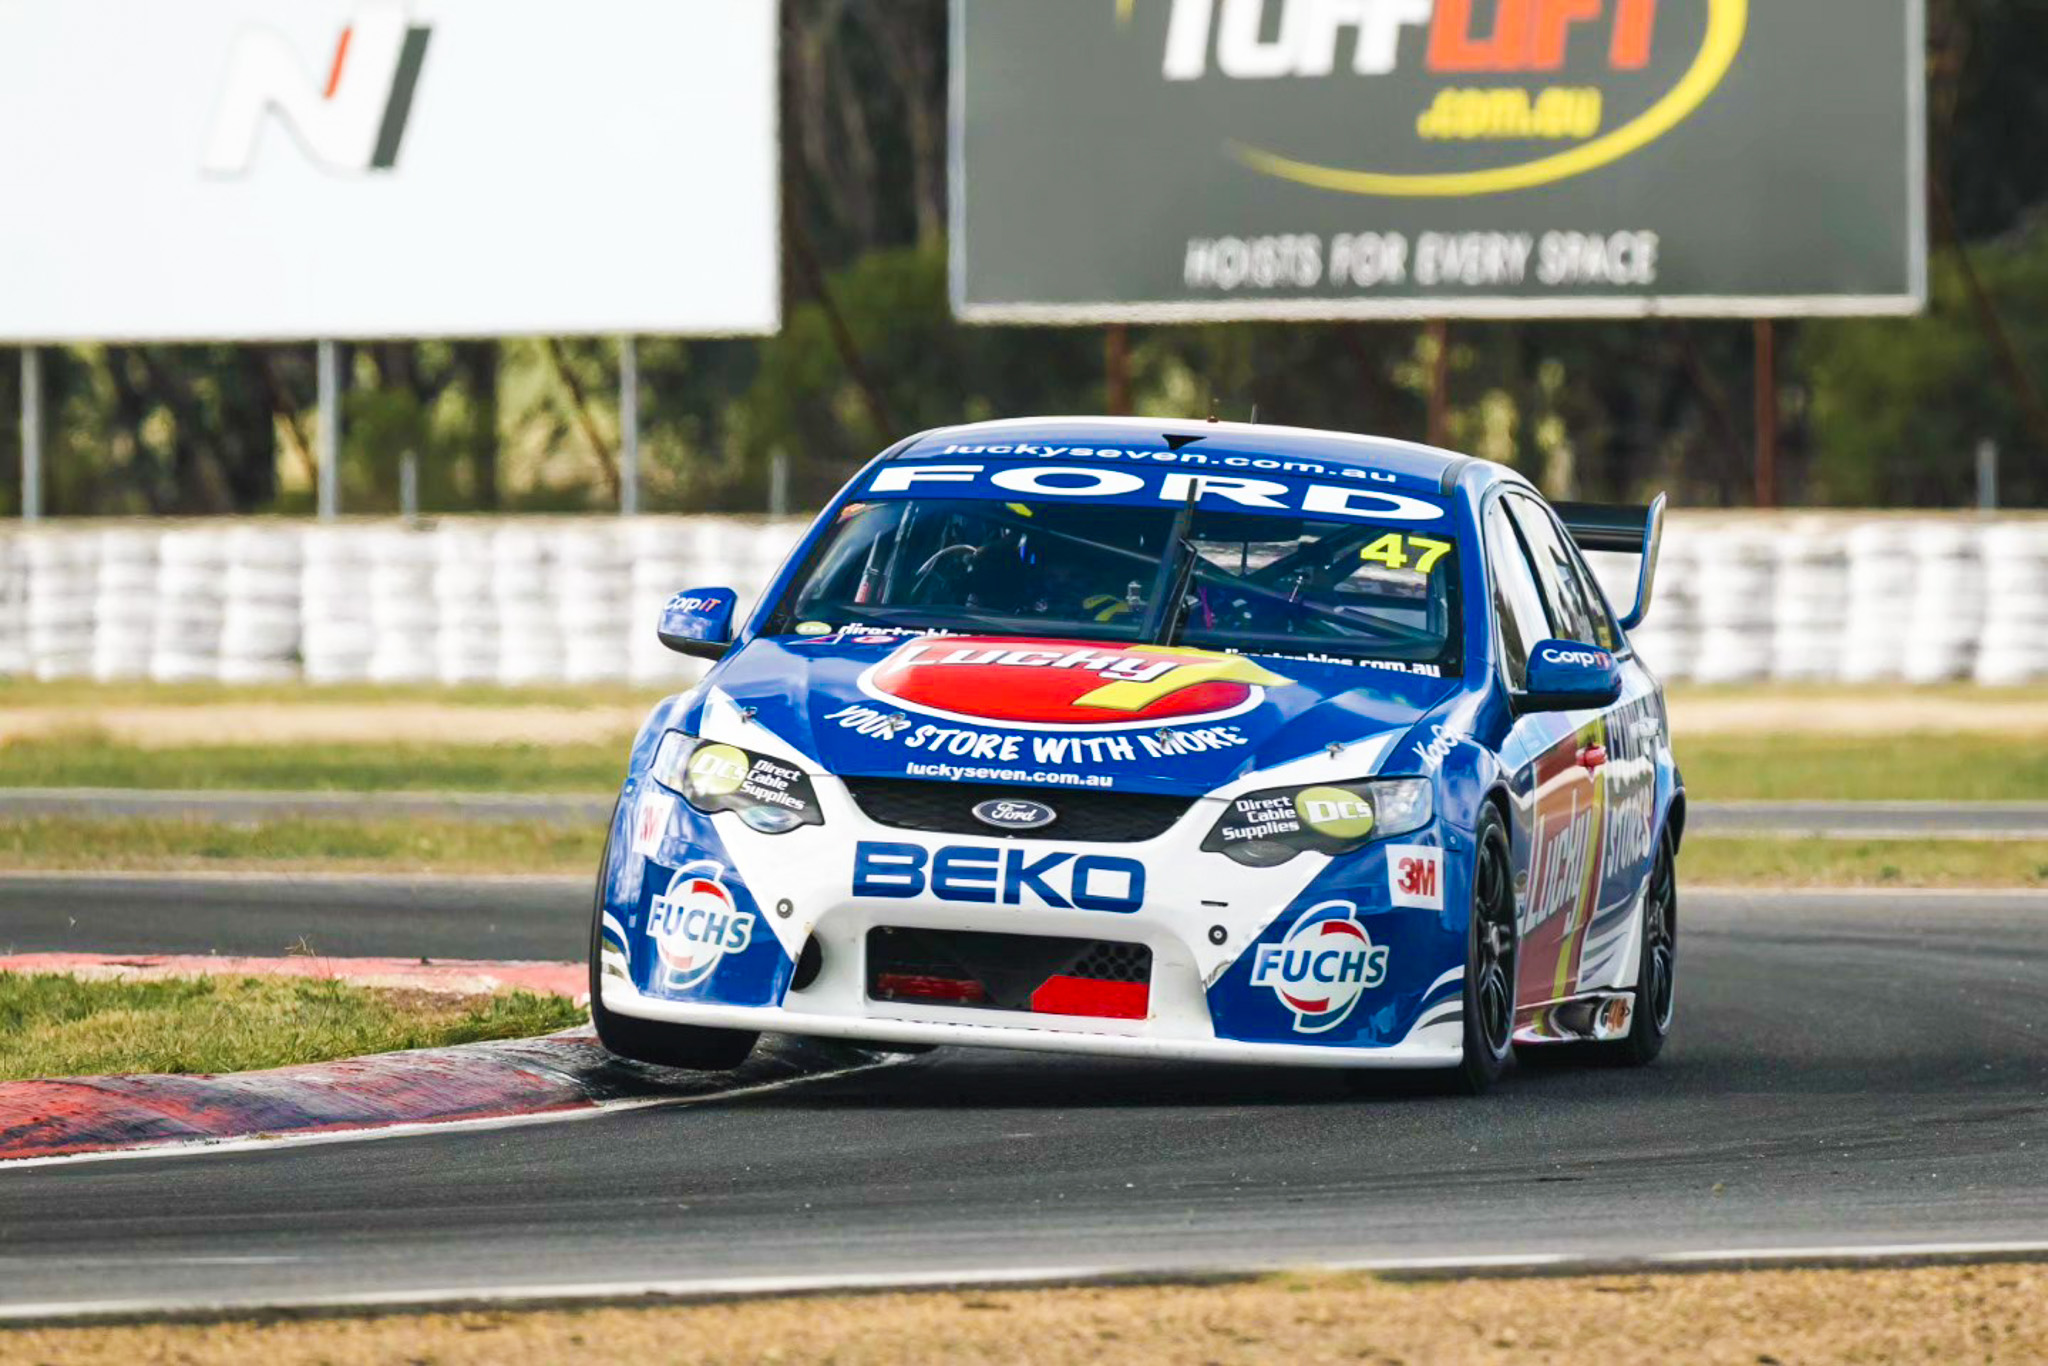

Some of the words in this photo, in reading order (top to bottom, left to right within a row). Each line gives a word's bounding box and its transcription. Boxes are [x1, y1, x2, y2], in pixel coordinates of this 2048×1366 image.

[1417, 87, 1602, 138] .com.au
[1184, 233, 1323, 290] HOISTS
[1329, 231, 1408, 287] FOR
[1413, 230, 1534, 286] EVERY
[1537, 229, 1660, 286] SPACE
[944, 443, 1398, 483] luckyseven.com.au
[868, 465, 1446, 520] FORD
[1360, 532, 1452, 574] 47
[888, 644, 1183, 683] Lucky
[824, 705, 912, 741] YOUR
[904, 724, 1025, 762] STORE
[1032, 736, 1137, 765] WITH
[746, 769, 790, 791] Cable
[753, 759, 803, 783] Direct
[905, 761, 1114, 788] luckyseven.com.au
[740, 780, 807, 811] Supplies
[991, 802, 1038, 822] Ford
[1235, 796, 1294, 813] Direct
[1222, 819, 1300, 842] Supplies
[1247, 808, 1297, 824] Cable
[853, 840, 1147, 915] BEKO
[1397, 856, 1437, 898] 3M
[1523, 789, 1593, 936] Lucky
[649, 900, 751, 949] FUCHS
[1256, 949, 1387, 985] FUCHS
